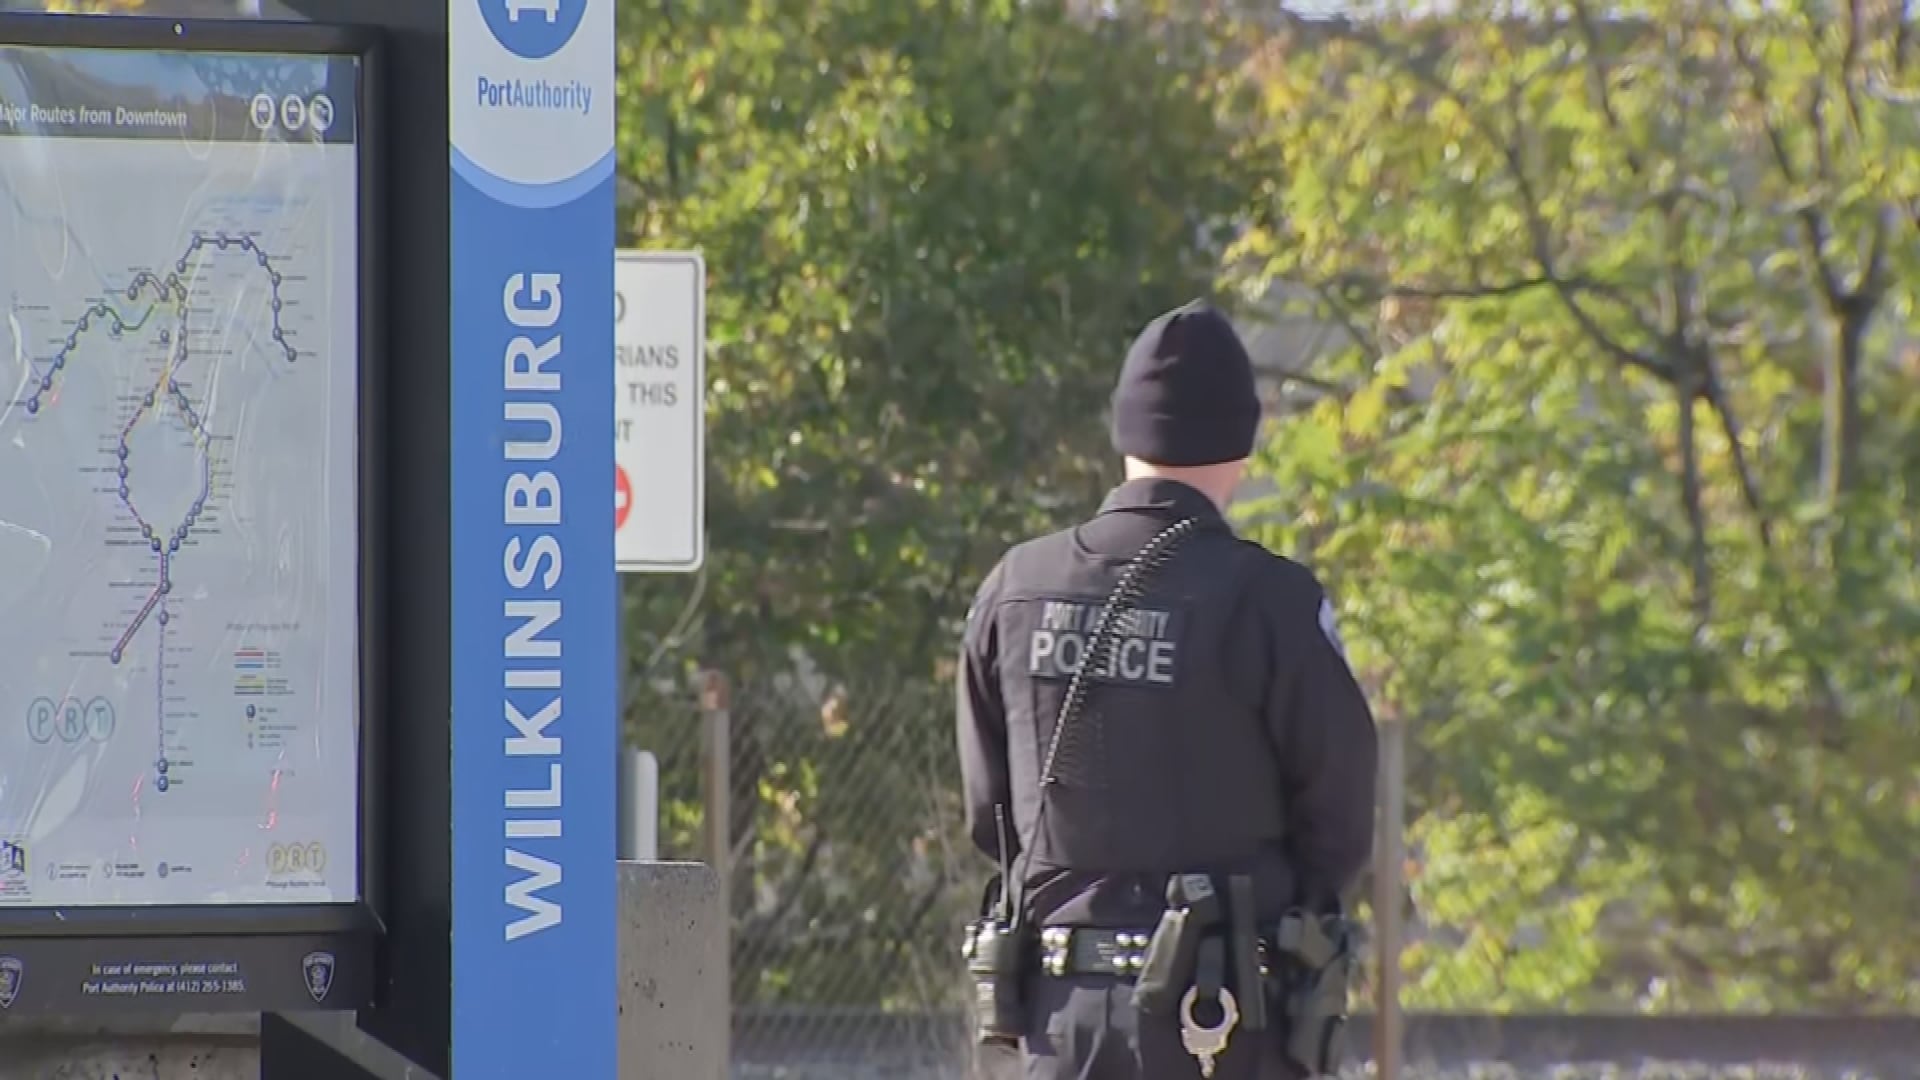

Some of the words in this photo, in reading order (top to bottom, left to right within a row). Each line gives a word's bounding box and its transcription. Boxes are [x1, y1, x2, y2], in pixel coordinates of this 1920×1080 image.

[477, 75, 592, 116] PortAuthority
[30, 103, 75, 124] Routes
[79, 104, 111, 125] from
[115, 105, 187, 127] Downtown
[627, 382, 679, 408] THIS
[503, 272, 563, 942] WILKINSBURG
[1029, 630, 1176, 683] POICE
[103, 964, 121, 975] case
[123, 963, 132, 975] of
[180, 963, 206, 976] please
[208, 963, 237, 974] contact
[82, 981, 100, 994] Port
[101, 981, 138, 996] Authority
[140, 981, 164, 993] Police
